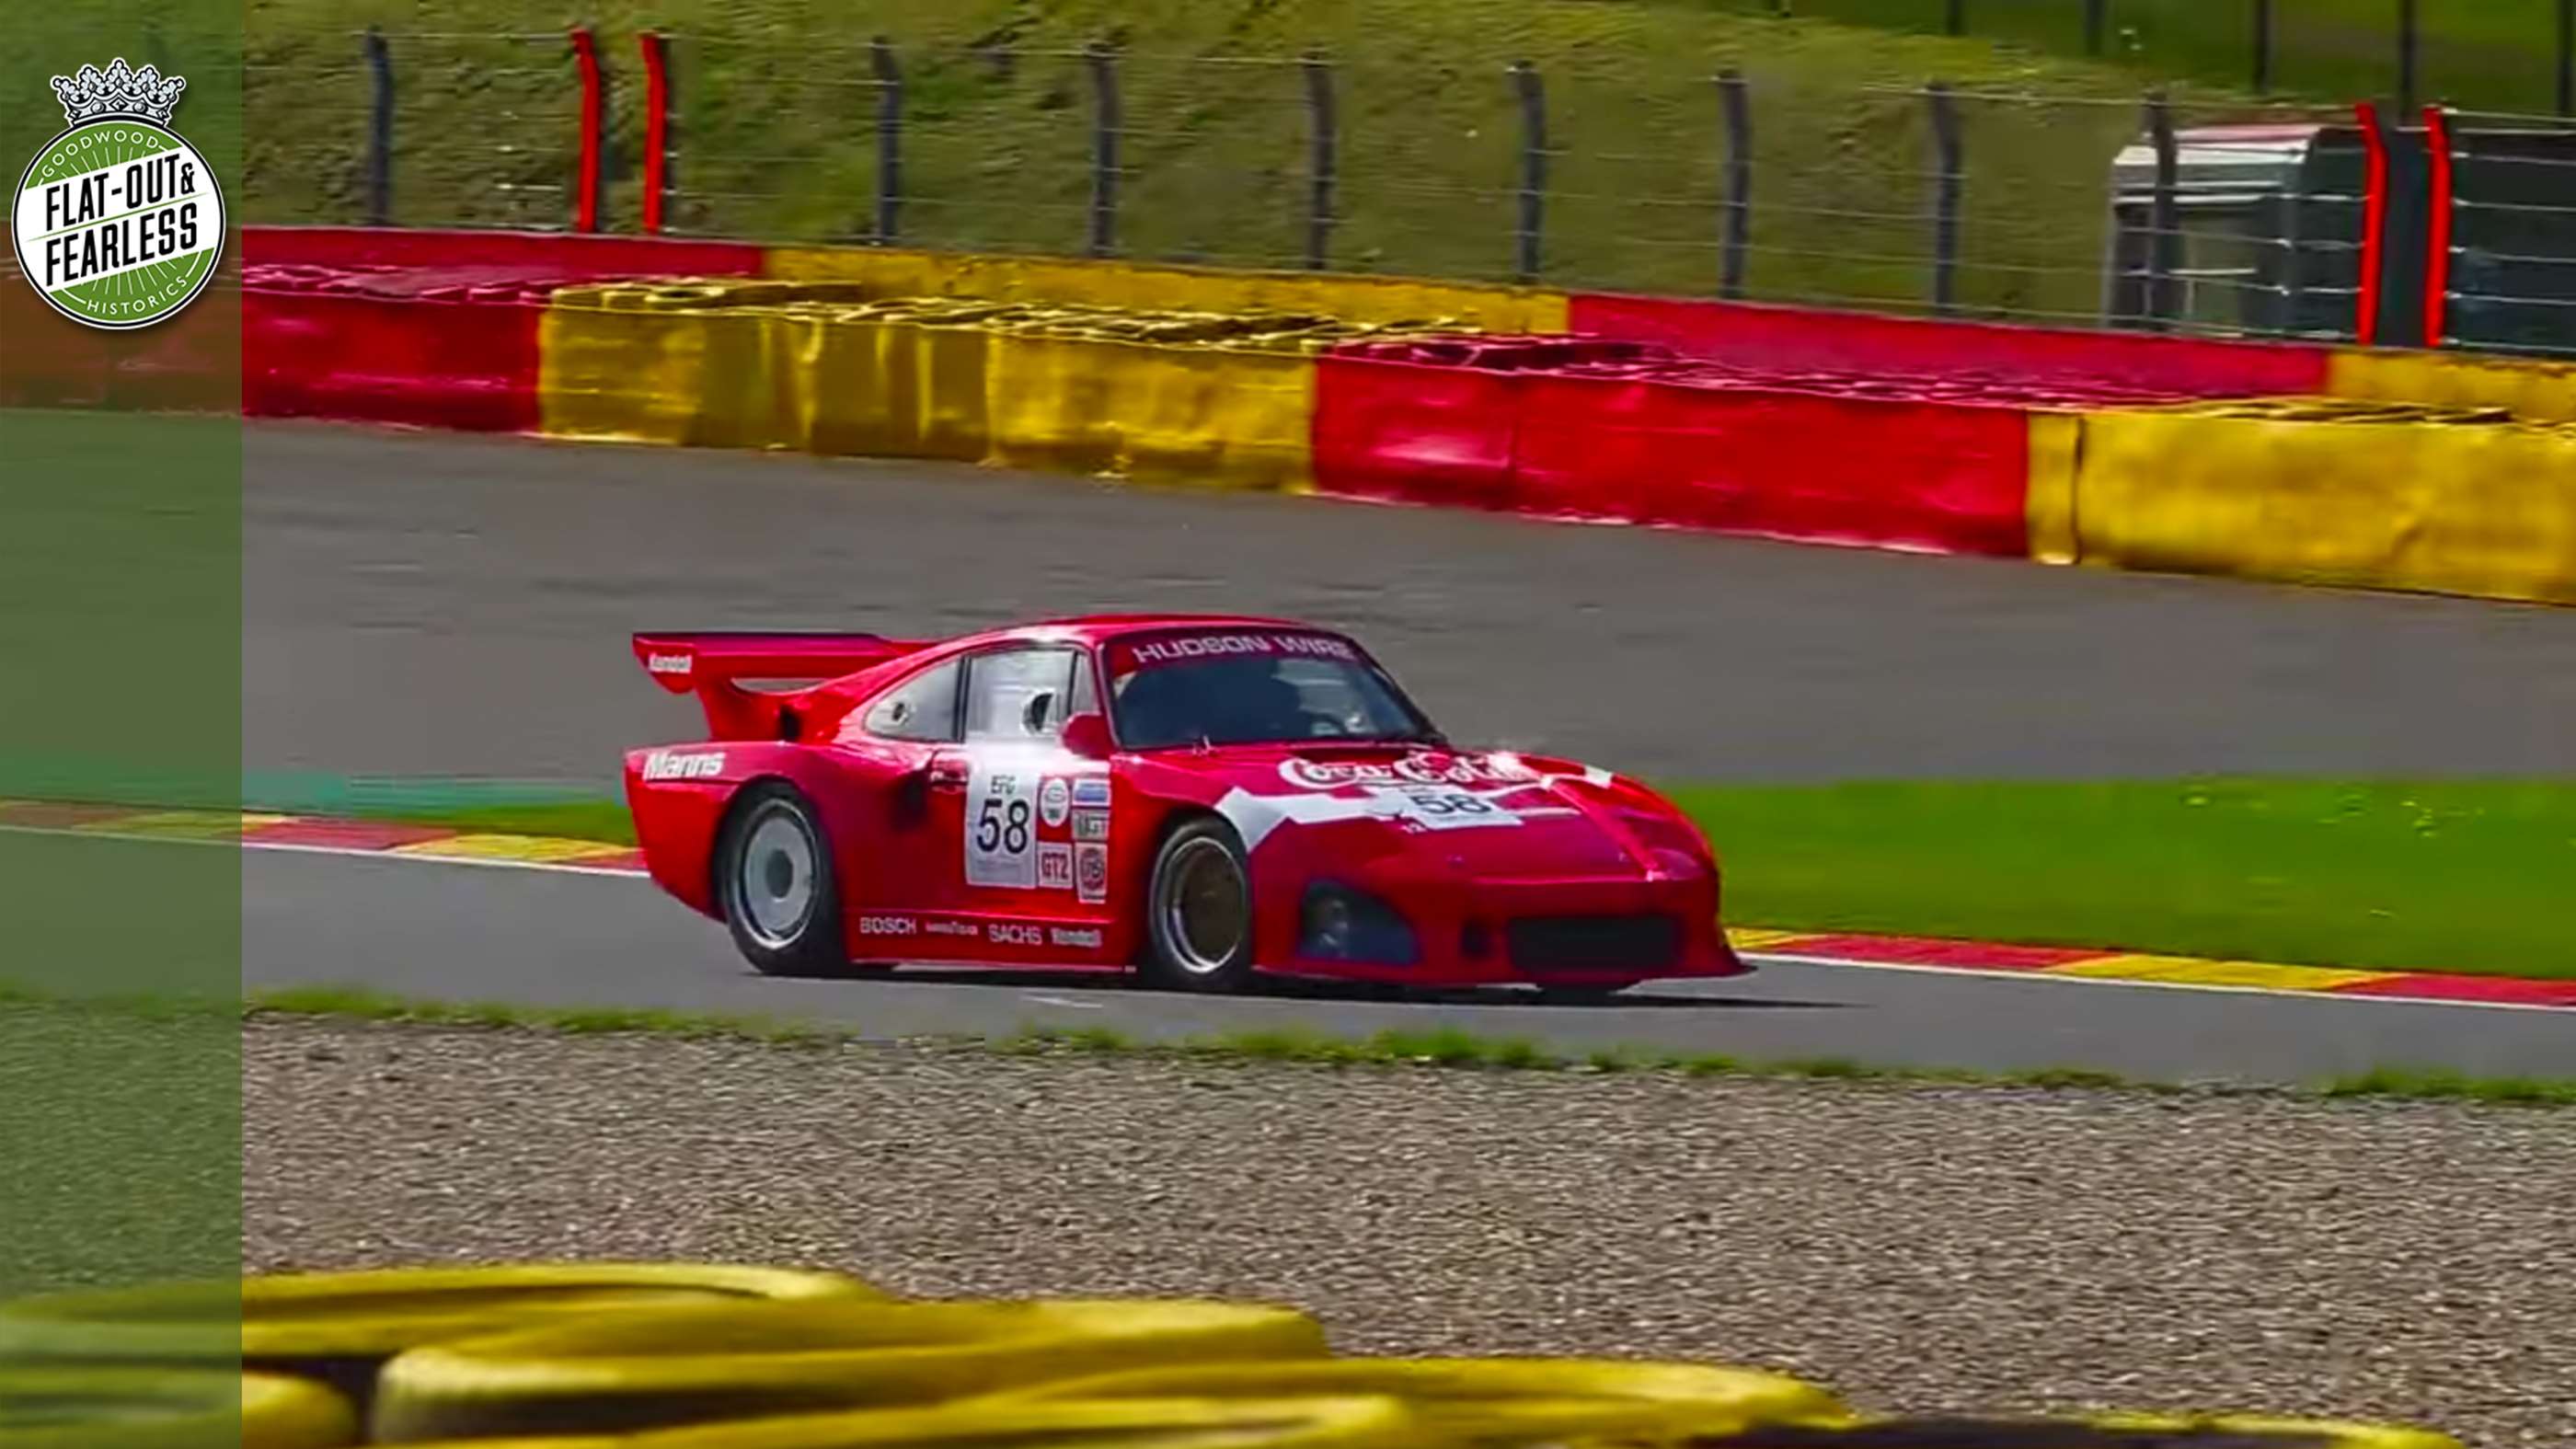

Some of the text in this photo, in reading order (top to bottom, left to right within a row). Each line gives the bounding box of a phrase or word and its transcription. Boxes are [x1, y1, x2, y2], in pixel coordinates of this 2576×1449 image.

[1133, 636, 1272, 662] HUDSON
[1409, 794, 1491, 814] 58
[976, 798, 1029, 855] 58
[859, 916, 916, 935] BOSCH
[988, 923, 1043, 946] SACHS
